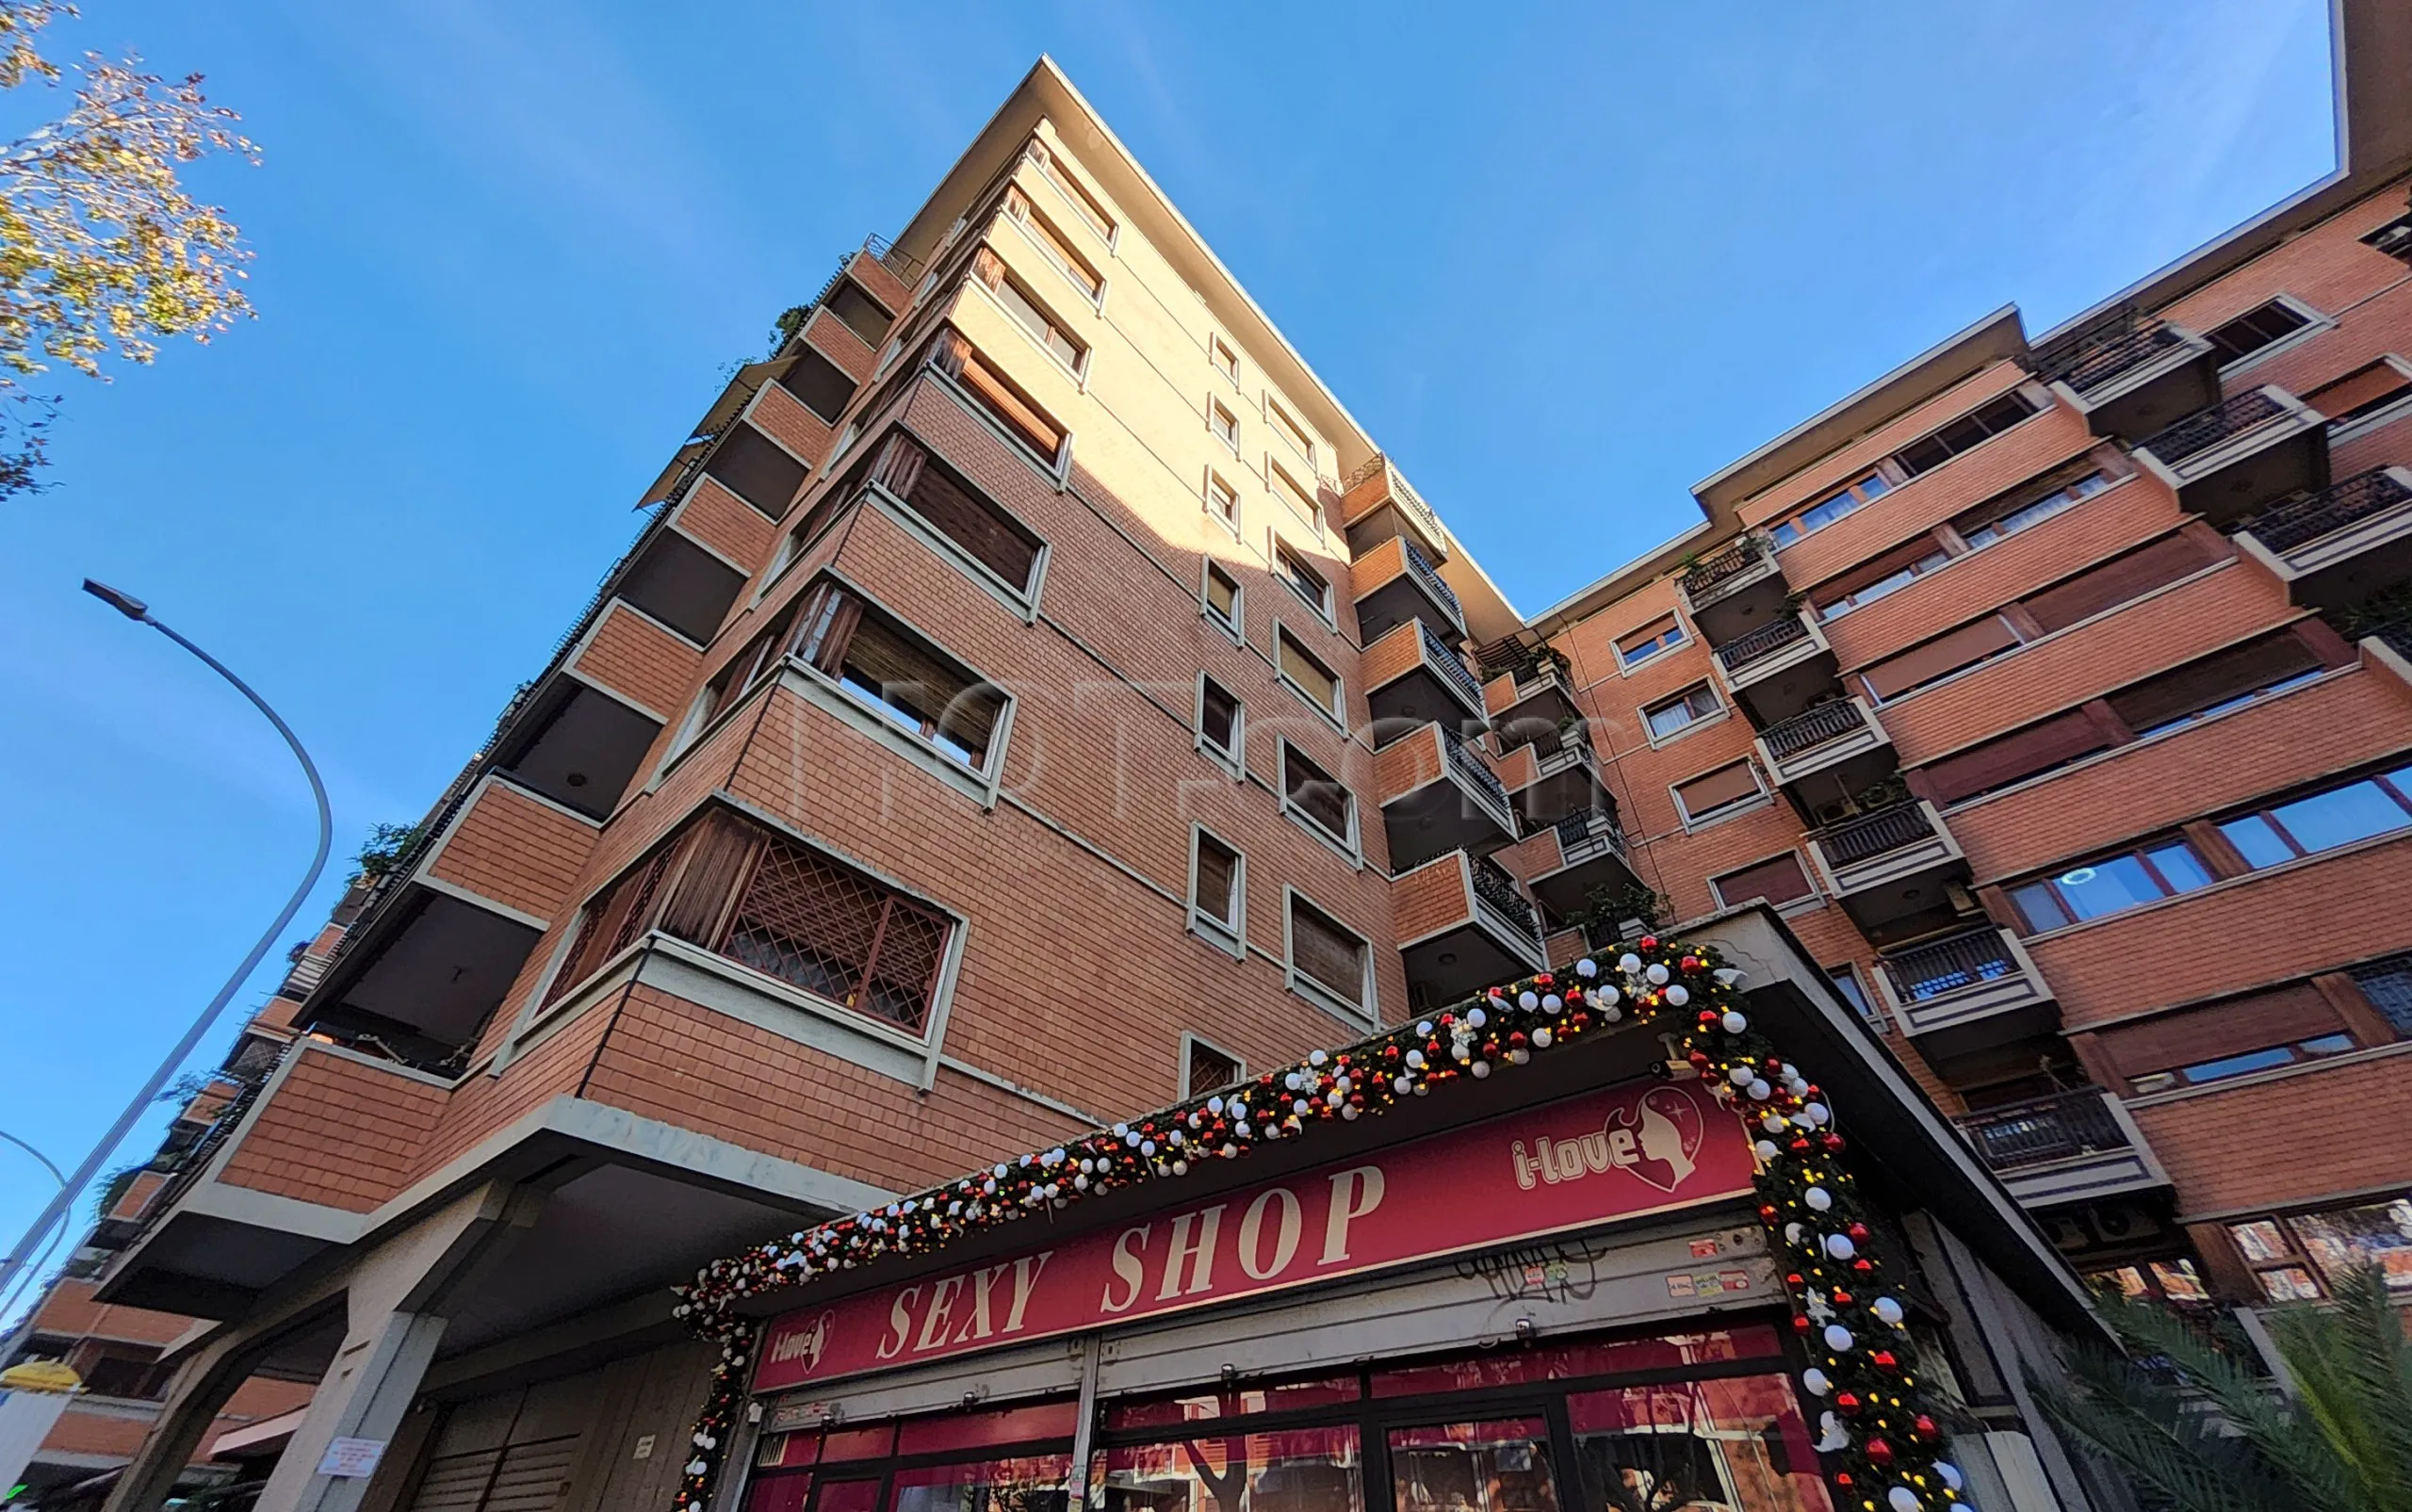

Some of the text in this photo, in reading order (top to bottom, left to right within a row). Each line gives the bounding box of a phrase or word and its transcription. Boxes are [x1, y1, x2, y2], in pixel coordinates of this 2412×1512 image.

[1511, 1128, 1641, 1191] i-love
[875, 1250, 1053, 1359] SEXY
[1100, 1165, 1385, 1312] SHOP
